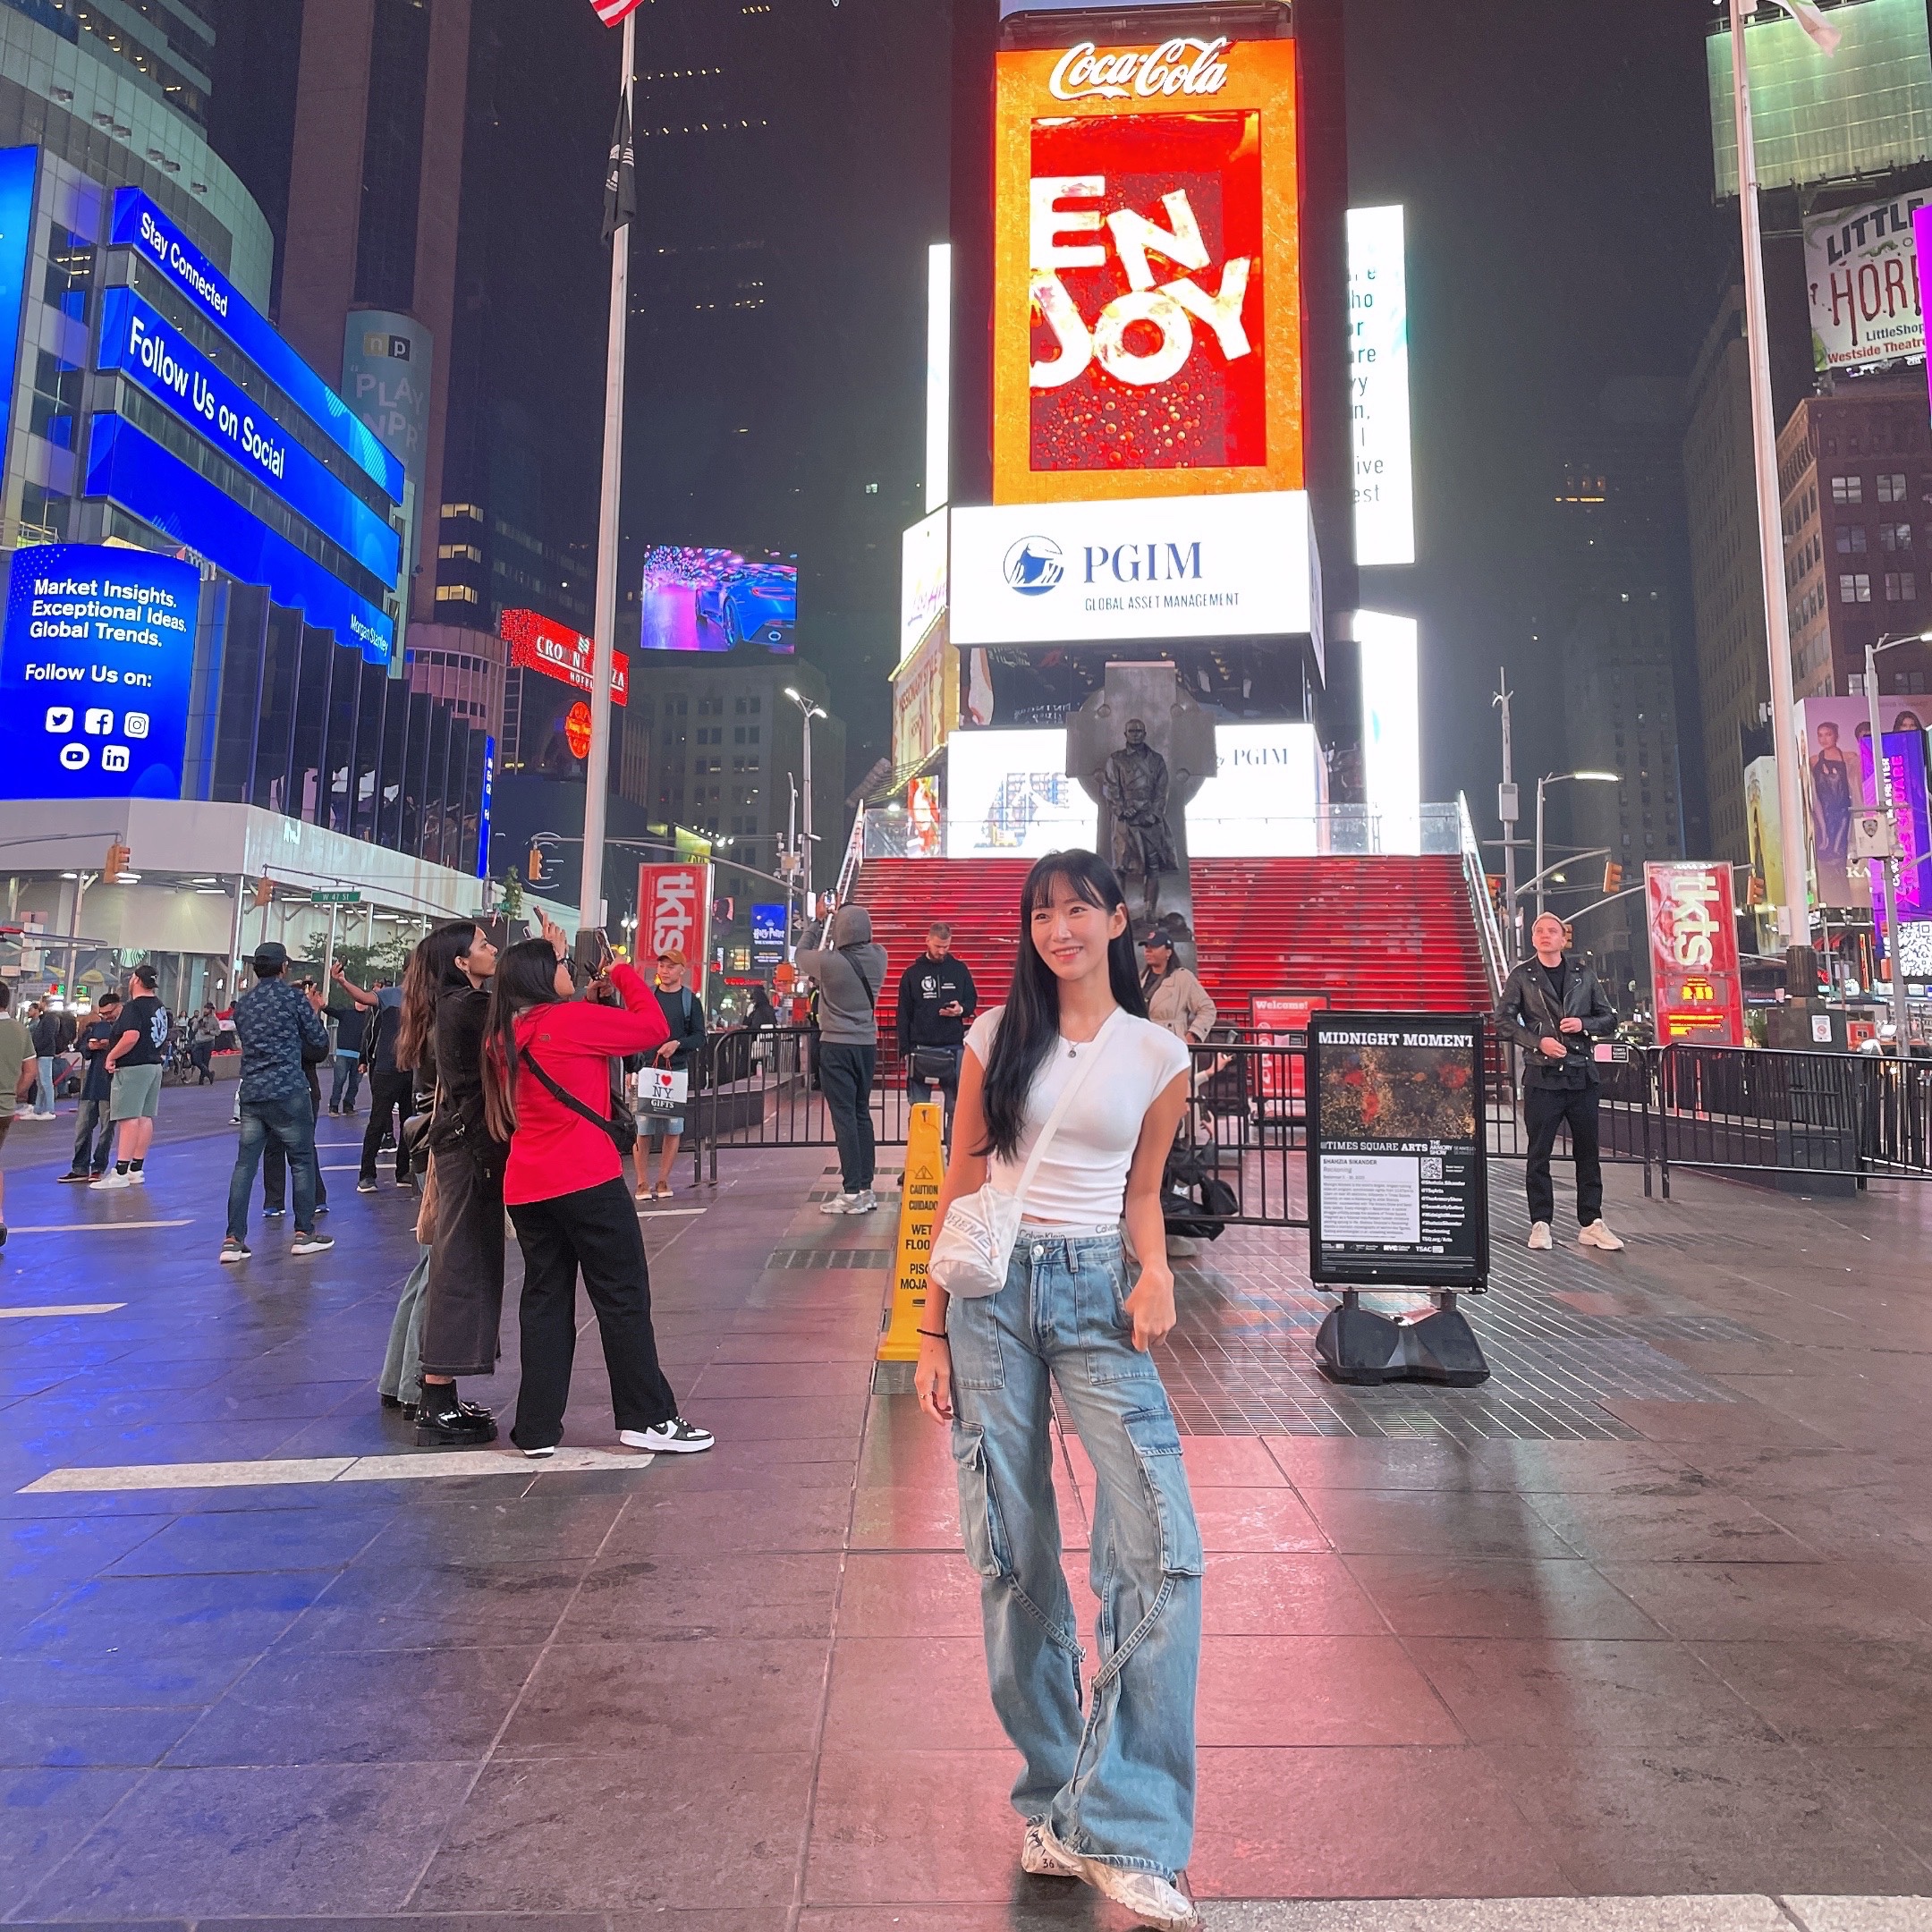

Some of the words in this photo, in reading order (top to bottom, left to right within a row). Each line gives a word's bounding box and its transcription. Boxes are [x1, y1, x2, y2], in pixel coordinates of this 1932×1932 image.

[1049, 37, 1231, 100] Coca-Cola
[140, 212, 168, 260] Stay
[170, 242, 228, 318] Connected
[1827, 346, 1880, 364] Westside
[130, 316, 189, 397] Follow
[192, 371, 215, 420] Us
[218, 405, 238, 441] on
[242, 417, 284, 479] Social
[1083, 541, 1203, 583] PGIM
[33, 579, 98, 596] Market
[103, 580, 177, 607] Insights.
[1085, 596, 1124, 611] GLOBAL
[1128, 595, 1160, 609] ASSET
[1164, 592, 1239, 608] MANAGEMENT
[31, 600, 142, 621] Exceptional
[30, 621, 89, 638] Global
[95, 623, 163, 647] Trends.
[350, 614, 370, 641] Morgan
[369, 627, 389, 657] Stanley
[537, 635, 586, 672] CRON
[25, 663, 86, 680] Follow
[91, 665, 119, 683] Us
[123, 672, 152, 687] on:
[1234, 748, 1288, 766] PGIM
[653, 871, 695, 956] tkts
[1673, 871, 1720, 966] tkts
[1255, 1000, 1309, 1010] Welcome!
[1318, 1031, 1400, 1046] MIDNIGHT
[1403, 1033, 1474, 1047] MOMENT
[655, 1073, 660, 1085] I
[652, 1085, 674, 1099] NY
[651, 1099, 674, 1109] GIFTS
[1326, 1141, 1359, 1150] TIMES
[1360, 1141, 1399, 1151] SQUARE
[1401, 1143, 1428, 1152] ARTS
[910, 1184, 938, 1195] CAUTION
[911, 1224, 932, 1235] WET
[905, 1240, 930, 1250] FLOO
[900, 1278, 928, 1290] MOJA
[1042, 1858, 1055, 1868] 36
